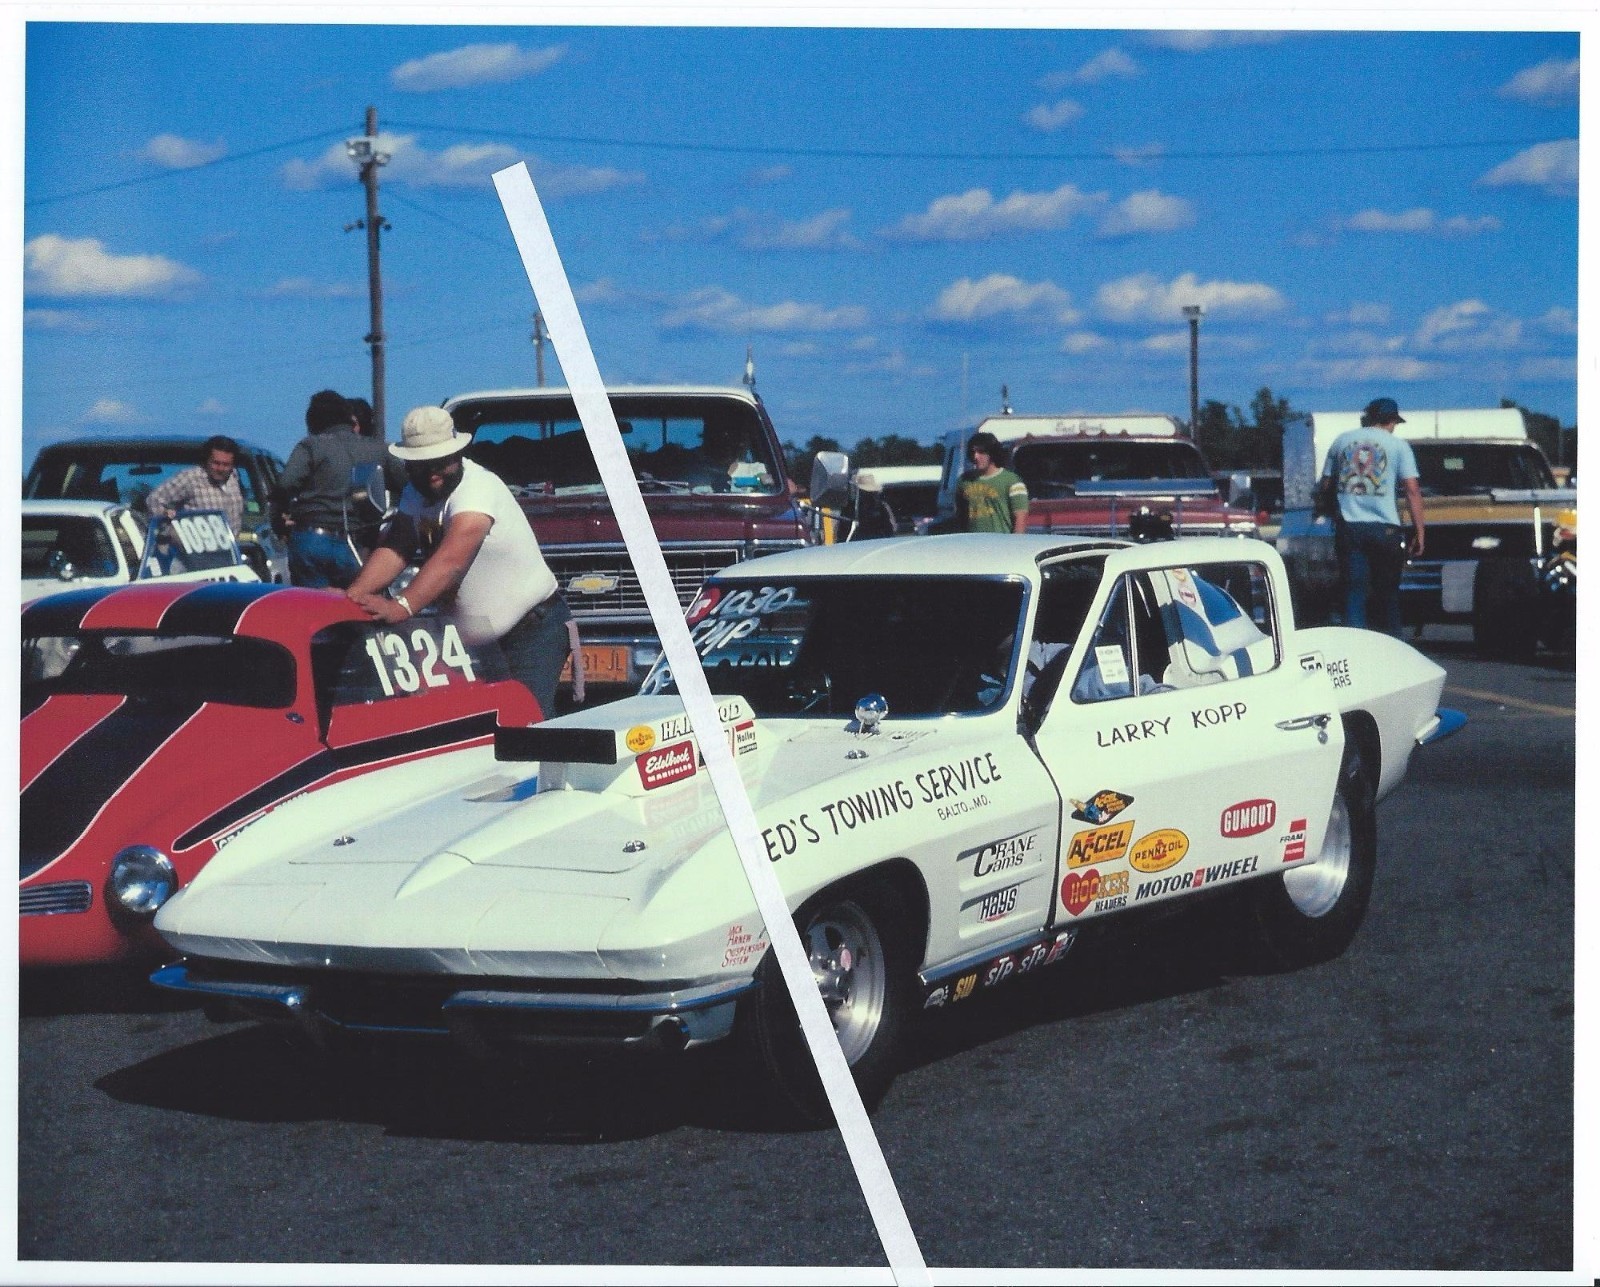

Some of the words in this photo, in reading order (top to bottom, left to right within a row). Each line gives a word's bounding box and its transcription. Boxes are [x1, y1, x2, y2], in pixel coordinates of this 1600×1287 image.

[365, 624, 476, 696] 1324
[1326, 658, 1349, 676] RACE
[1332, 674, 1352, 689] ARS
[1097, 716, 1172, 748] LARRY
[1190, 702, 1248, 728] KOPP
[644, 747, 690, 773] Edelbrock
[647, 763, 693, 783] MANIFOLDS
[821, 780, 914, 836] TOWING
[915, 752, 1002, 803] SERVICE
[1223, 802, 1273, 834] GUMOUT
[1068, 830, 1127, 864] ACCEL
[1134, 839, 1184, 862] PENNZOIL
[1279, 833, 1304, 844] FRAM
[1070, 871, 1129, 905] HOOKER
[1135, 871, 1194, 901] MOTOR
[1205, 855, 1259, 884] WHEEL
[1095, 895, 1127, 913] HEADERS
[985, 956, 1024, 987] STP
[1018, 944, 1047, 974] STP
